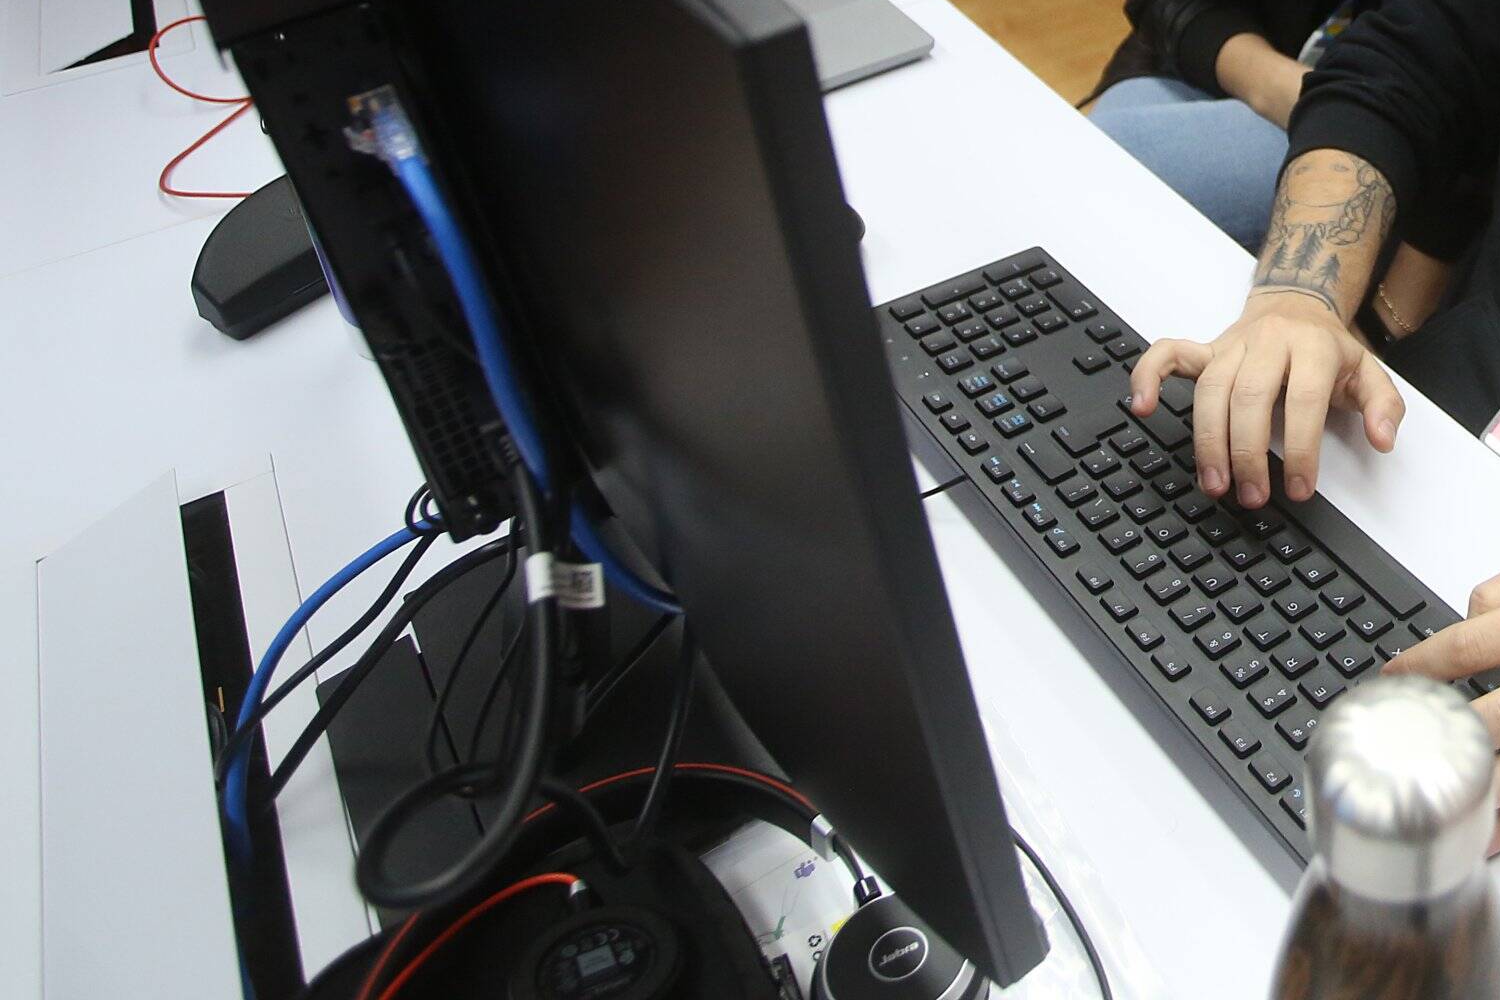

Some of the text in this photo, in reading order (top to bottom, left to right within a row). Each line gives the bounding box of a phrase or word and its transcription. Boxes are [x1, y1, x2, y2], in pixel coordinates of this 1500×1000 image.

[1256, 521, 1268, 530] M
[1210, 528, 1222, 536] K
[1058, 540, 1067, 548] F9
[1281, 545, 1293, 554] N
[1308, 570, 1319, 578] B
[1090, 577, 1100, 586] F8
[1206, 578, 1217, 587] U
[1260, 577, 1272, 586] H
[1114, 605, 1125, 613] F7
[1231, 606, 1242, 614] Y
[1287, 602, 1298, 611] G
[1363, 621, 1374, 630] C
[1140, 632, 1150, 642] F6
[1222, 632, 1232, 640] 6
[1258, 632, 1268, 640] T
[1314, 631, 1326, 639] F
[1249, 660, 1259, 668] 5
[1286, 658, 1298, 668] R
[1344, 658, 1355, 666] D
[1167, 662, 1177, 672] F5
[1314, 687, 1326, 697] E
[1206, 706, 1216, 715] F4
[1306, 719, 1316, 728] 3
[1236, 738, 1246, 748] F3
[1266, 772, 1277, 782] F2
